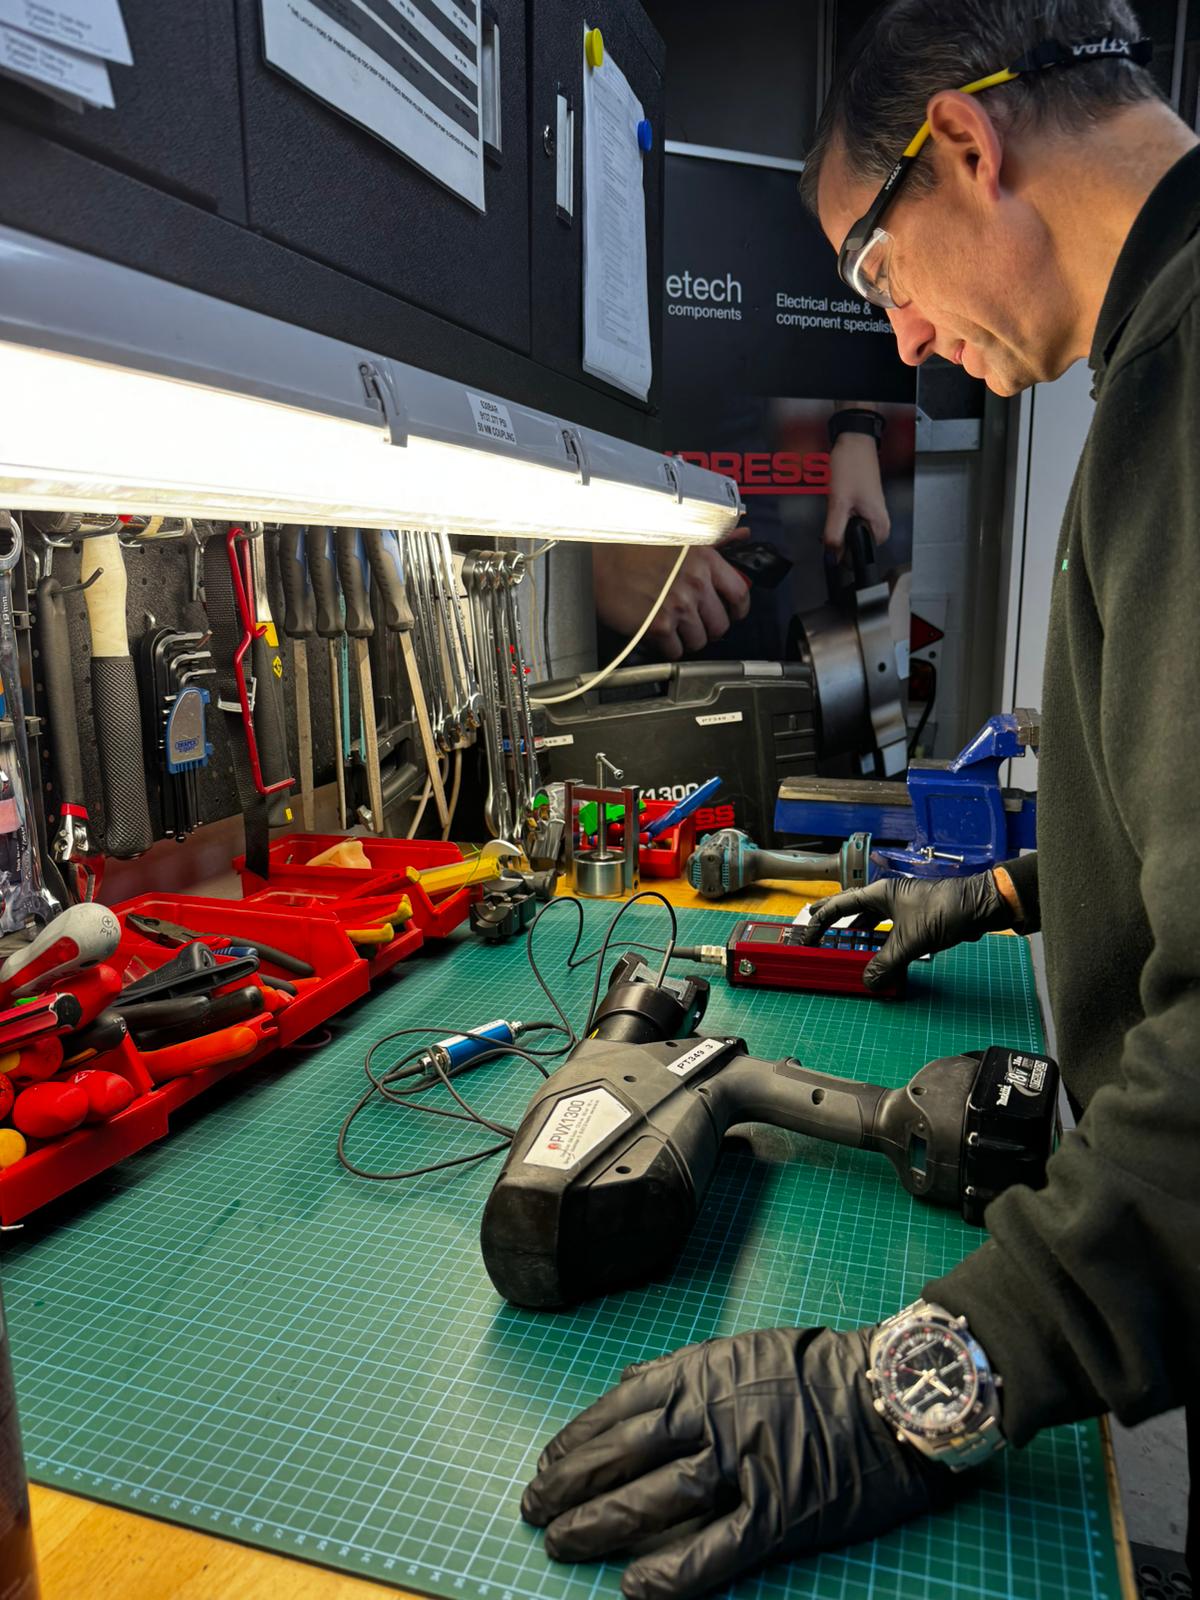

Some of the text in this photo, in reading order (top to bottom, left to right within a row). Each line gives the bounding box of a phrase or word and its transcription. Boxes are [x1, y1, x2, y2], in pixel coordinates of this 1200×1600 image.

[666, 270, 742, 303] etech
[668, 304, 742, 320] components
[776, 293, 872, 315] Electrical cable &
[776, 313, 841, 330] component
[549, 1099, 585, 1143] PVX1300
